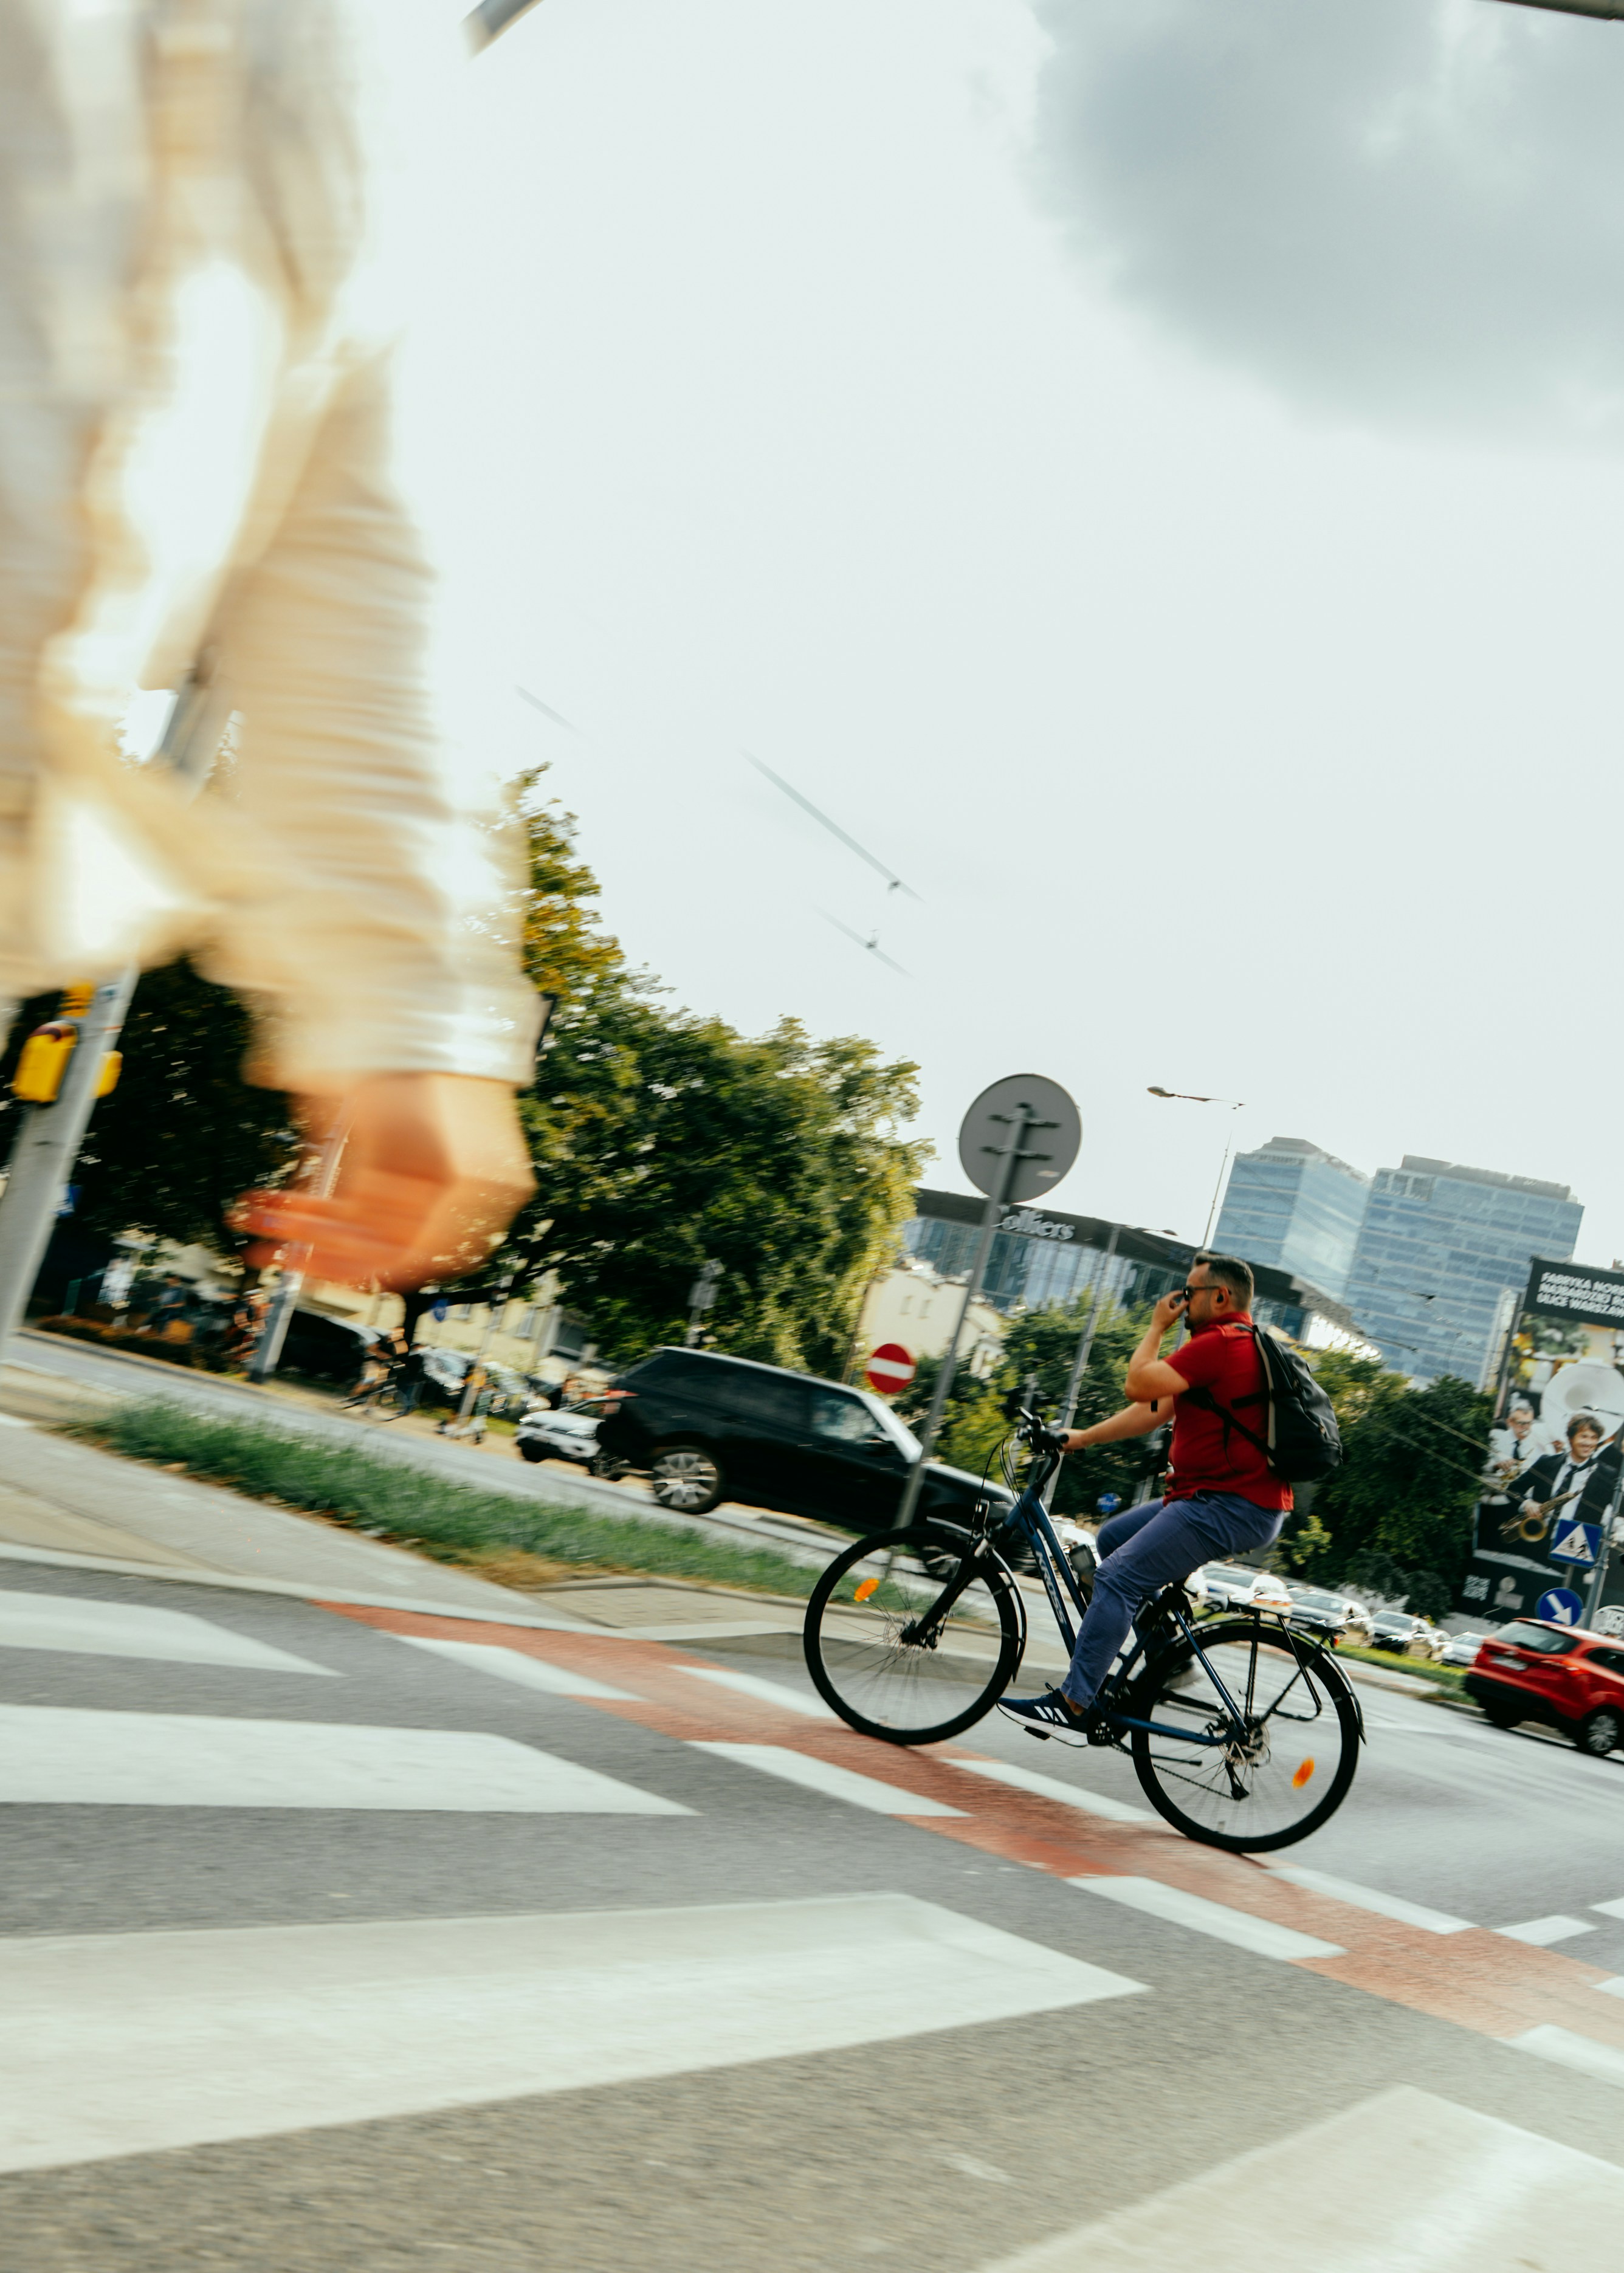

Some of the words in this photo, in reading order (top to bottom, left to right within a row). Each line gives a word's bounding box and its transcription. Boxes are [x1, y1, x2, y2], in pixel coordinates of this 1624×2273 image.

[1541, 1272, 1592, 1290] FABRYKA
[1536, 1292, 1569, 1307] ULICE
[1035, 1550, 1067, 1624] KROSS
